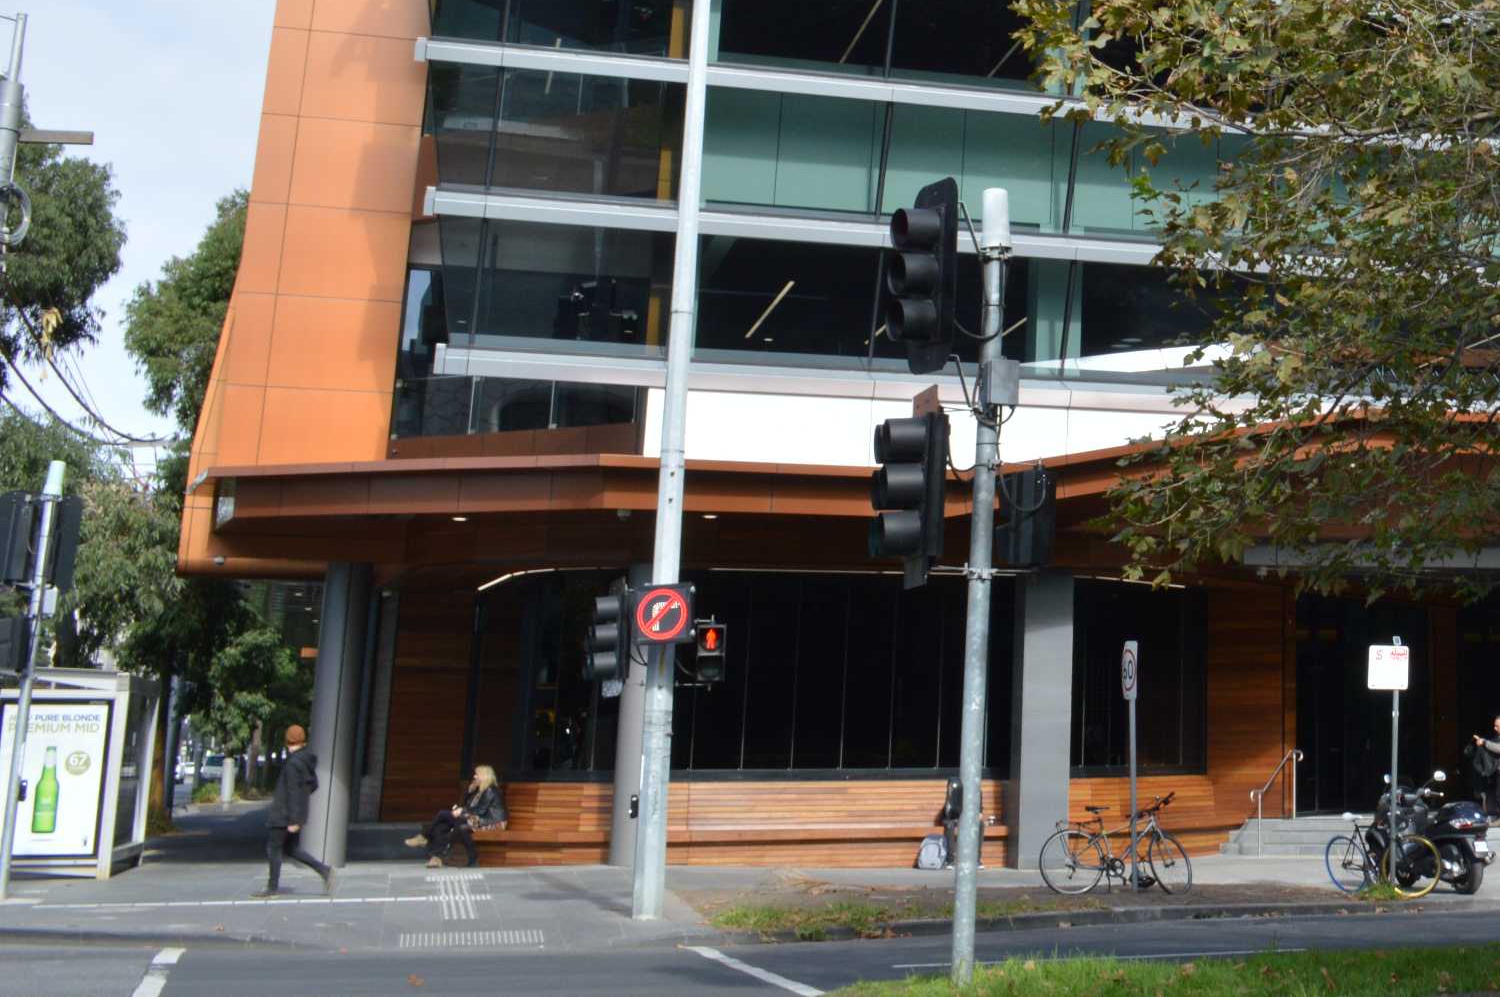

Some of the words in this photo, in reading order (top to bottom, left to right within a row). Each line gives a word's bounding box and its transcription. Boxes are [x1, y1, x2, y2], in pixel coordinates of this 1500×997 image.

[35, 714, 59, 722] PURE
[63, 713, 100, 722] BLONDE
[9, 722, 70, 734] PEMIUM
[75, 722, 100, 733] MID
[69, 753, 87, 766] 67
